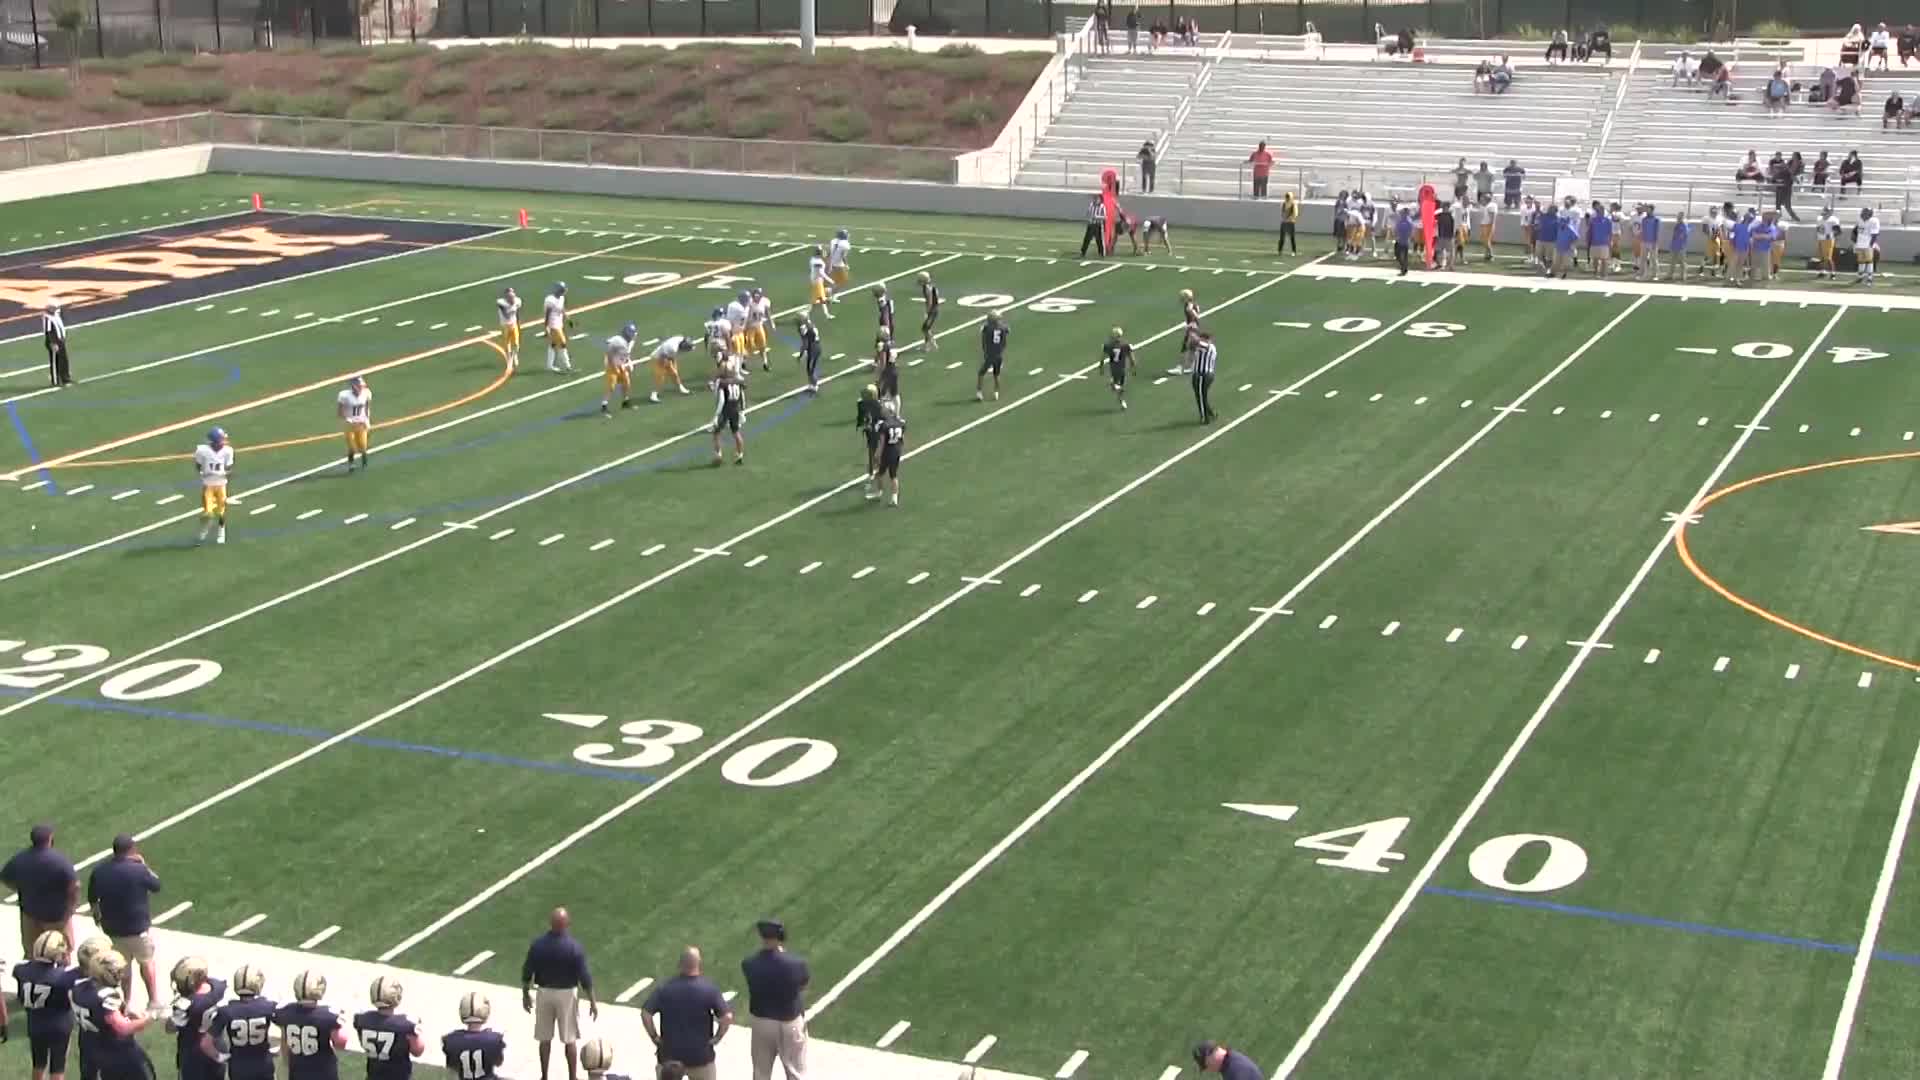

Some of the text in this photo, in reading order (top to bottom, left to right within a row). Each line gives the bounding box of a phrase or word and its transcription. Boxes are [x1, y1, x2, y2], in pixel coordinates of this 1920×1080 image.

[22, 982, 52, 1009] 17
[230, 1017, 267, 1047] 35
[286, 1024, 319, 1056] 66
[362, 1030, 395, 1061] 57
[459, 1048, 486, 1080] 11
